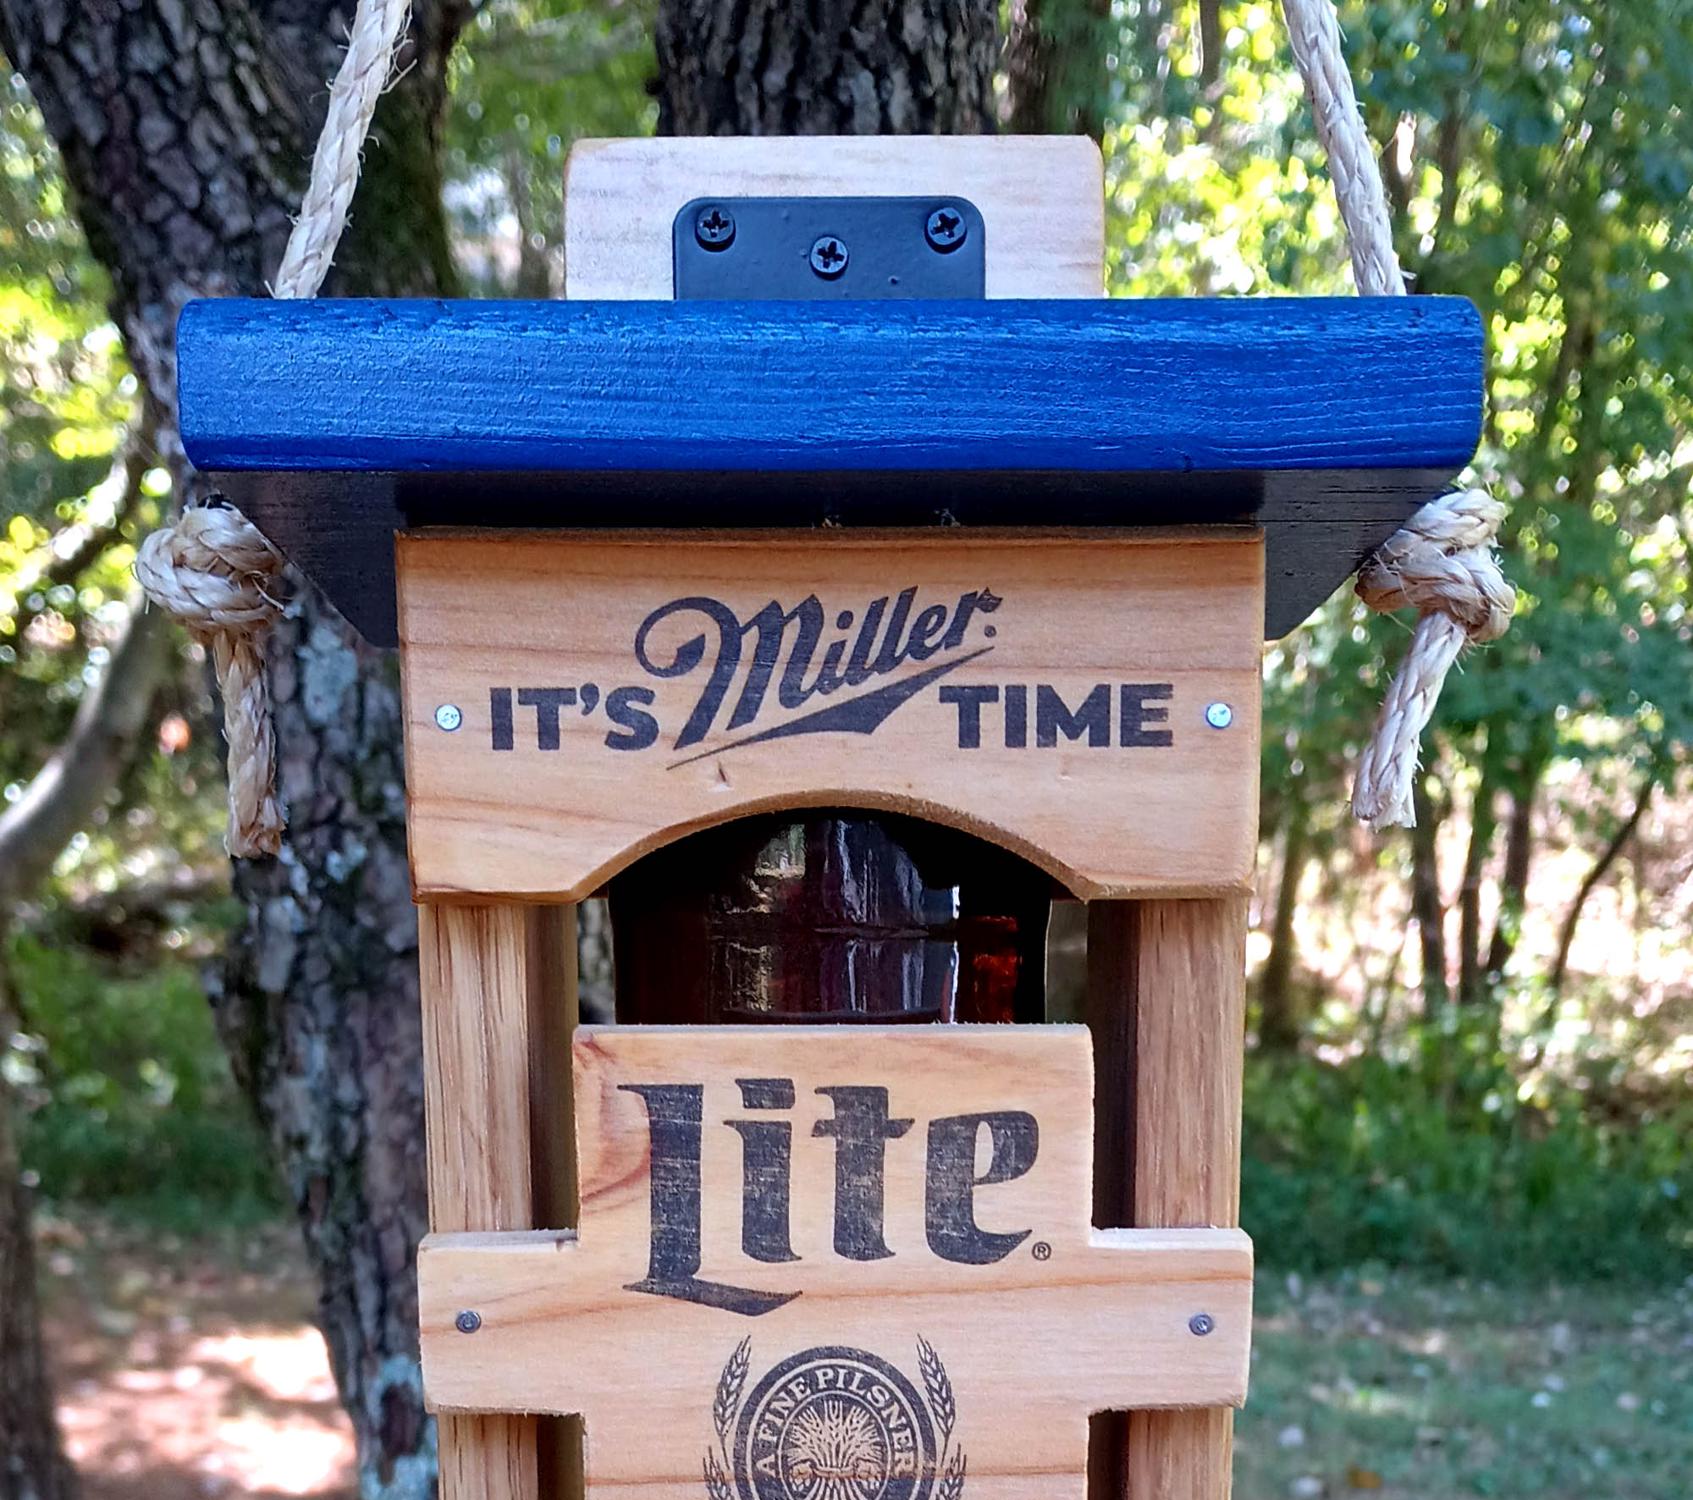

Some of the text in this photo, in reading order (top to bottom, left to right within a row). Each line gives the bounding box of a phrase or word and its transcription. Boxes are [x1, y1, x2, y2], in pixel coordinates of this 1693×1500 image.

[489, 585, 1174, 752] IT'S Miller TIME
[617, 1077, 1040, 1316] Lite
[755, 1366, 915, 1478] A FINE PILSNER
